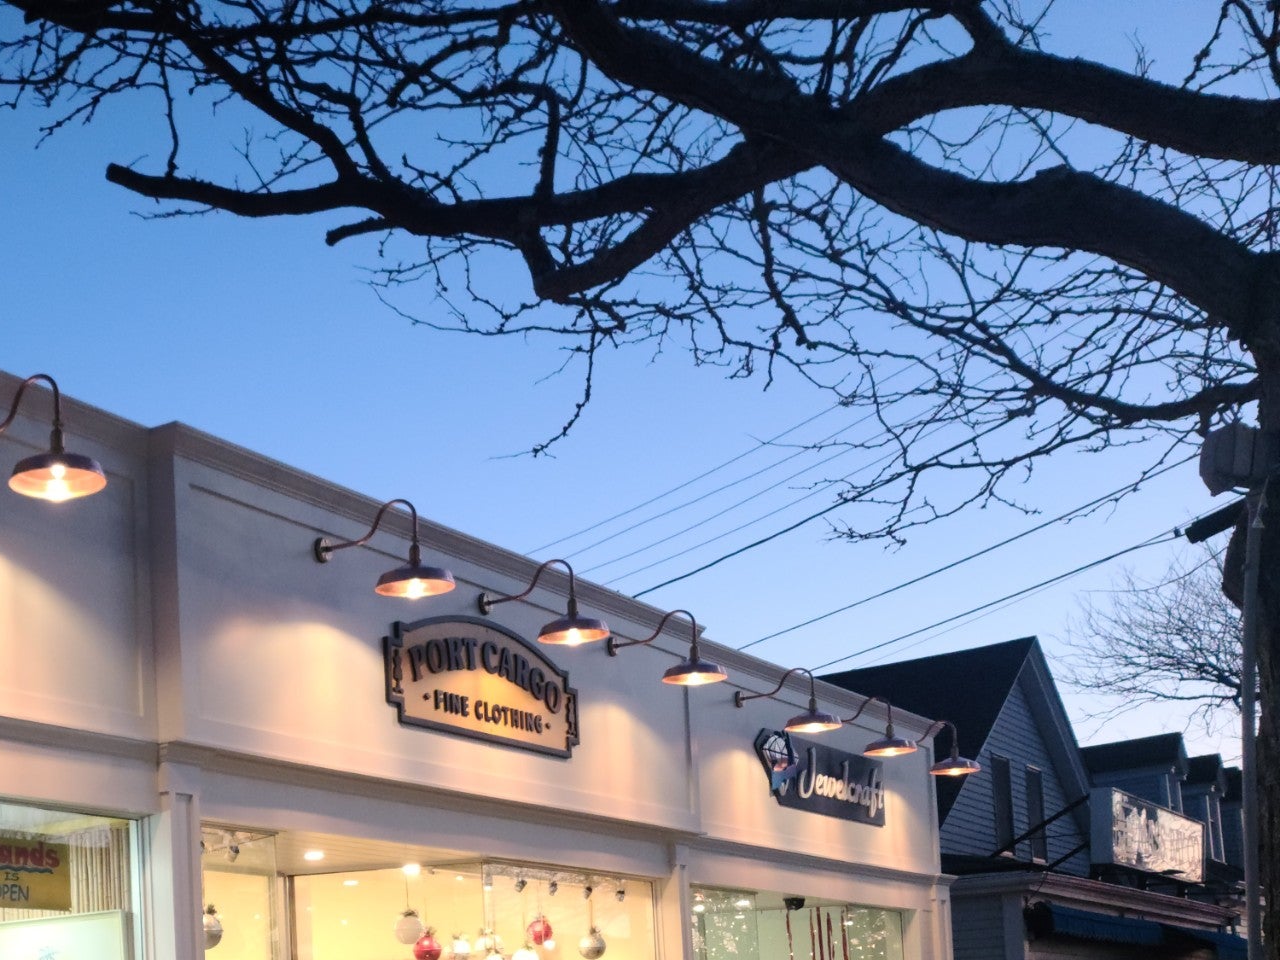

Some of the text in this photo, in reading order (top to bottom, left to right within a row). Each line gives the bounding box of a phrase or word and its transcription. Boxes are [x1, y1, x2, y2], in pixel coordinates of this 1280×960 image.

[408, 637, 562, 713] PORT CARGO
[435, 689, 543, 733] FINE CLOTHING
[799, 746, 883, 818] Jewelcraft
[4, 872, 19, 881] IS
